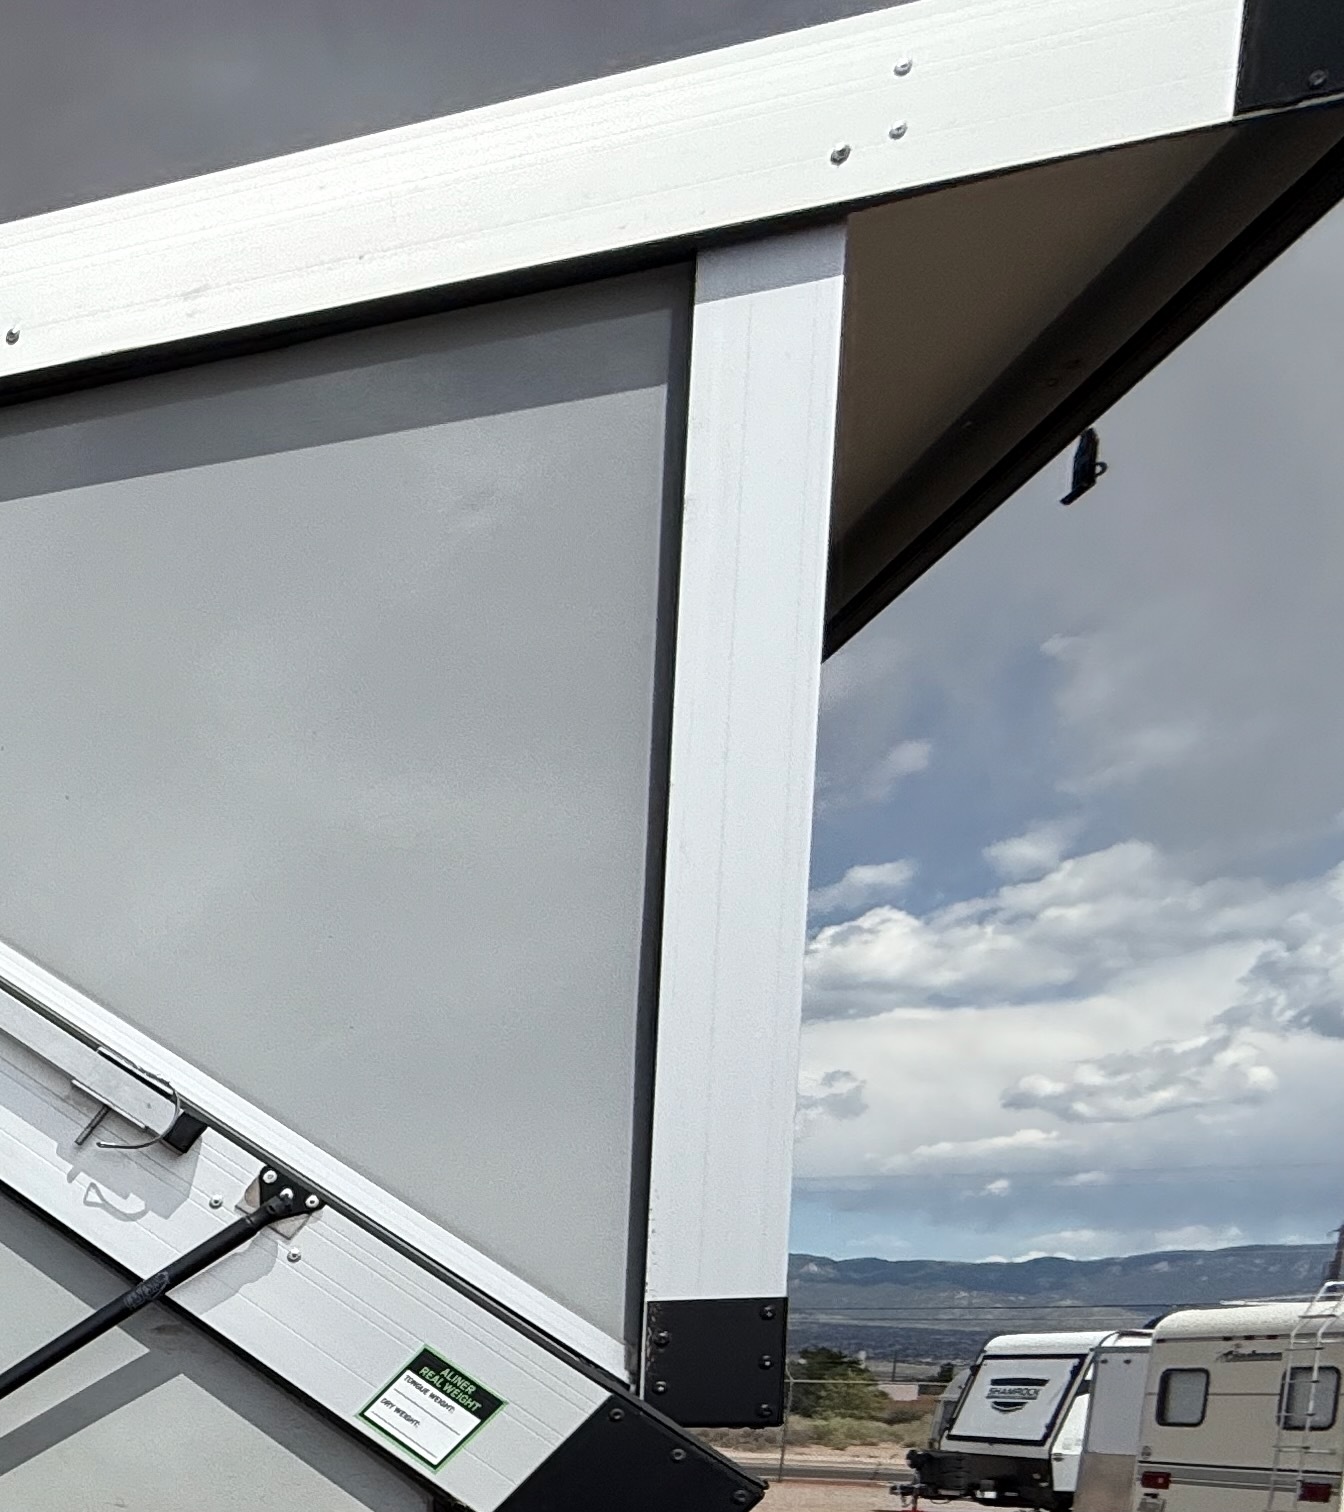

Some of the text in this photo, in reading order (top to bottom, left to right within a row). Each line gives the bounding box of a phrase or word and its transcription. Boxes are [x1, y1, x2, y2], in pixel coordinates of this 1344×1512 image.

[404, 1374, 430, 1396] TONGUE
[419, 1366, 482, 1411] REAL WEIGHT
[440, 1368, 477, 1395] ALINER
[380, 1397, 395, 1410] DRY
